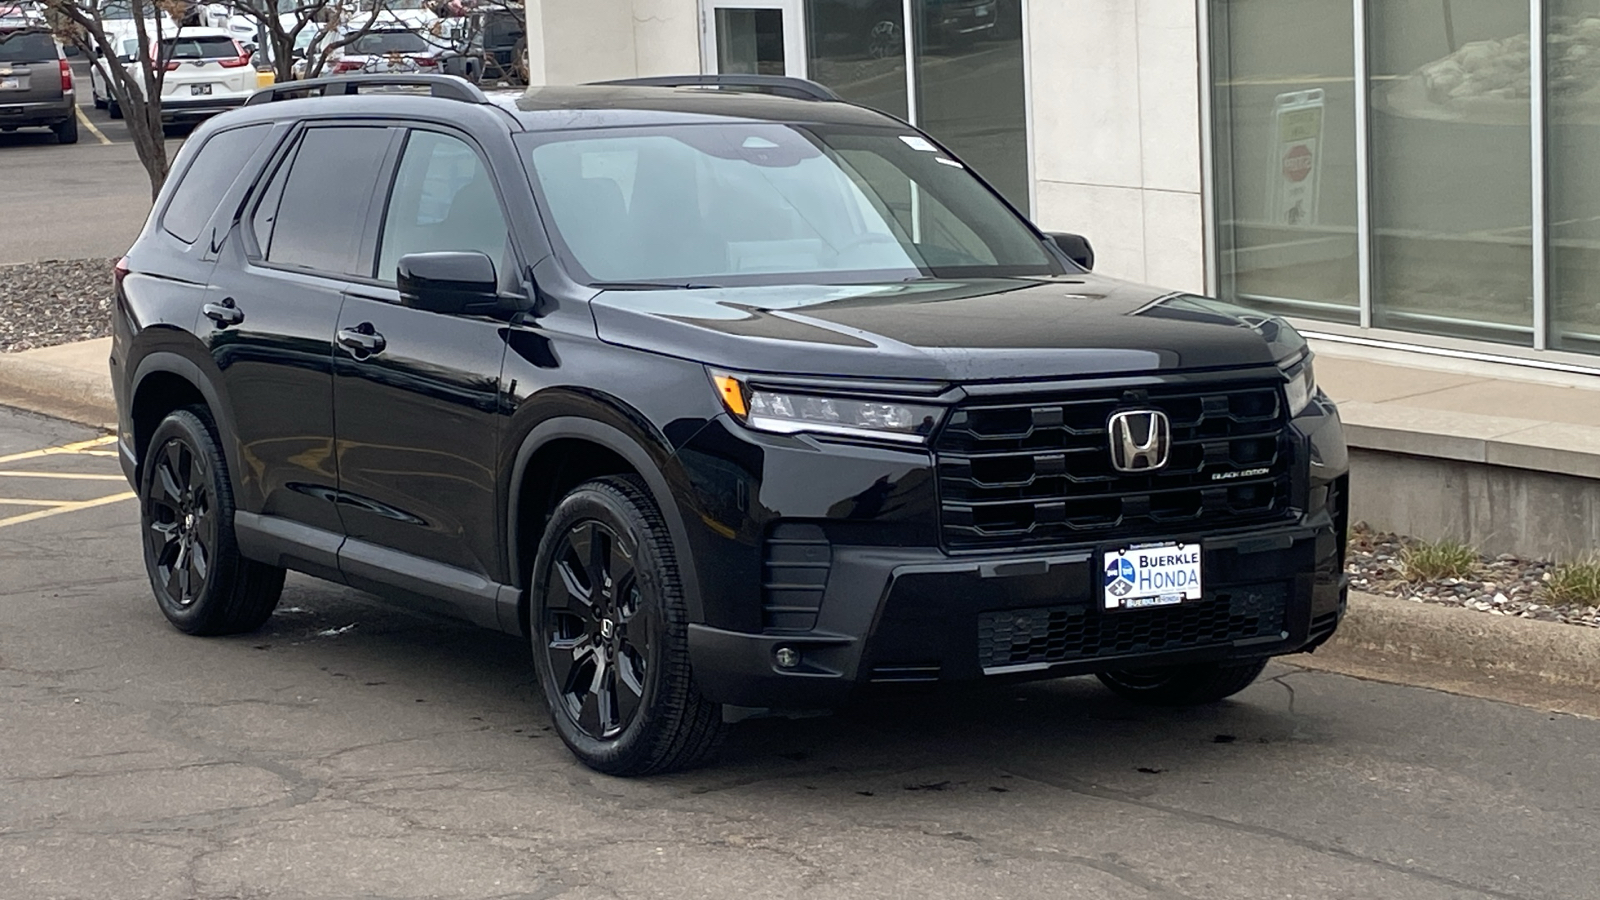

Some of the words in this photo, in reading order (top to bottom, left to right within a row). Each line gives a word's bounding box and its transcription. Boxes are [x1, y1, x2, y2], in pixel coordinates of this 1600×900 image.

[1211, 472, 1240, 480] BLACK
[1240, 468, 1269, 477] EDITION
[1139, 553, 1199, 568] BUERKLE
[1139, 569, 1199, 590] HONDA
